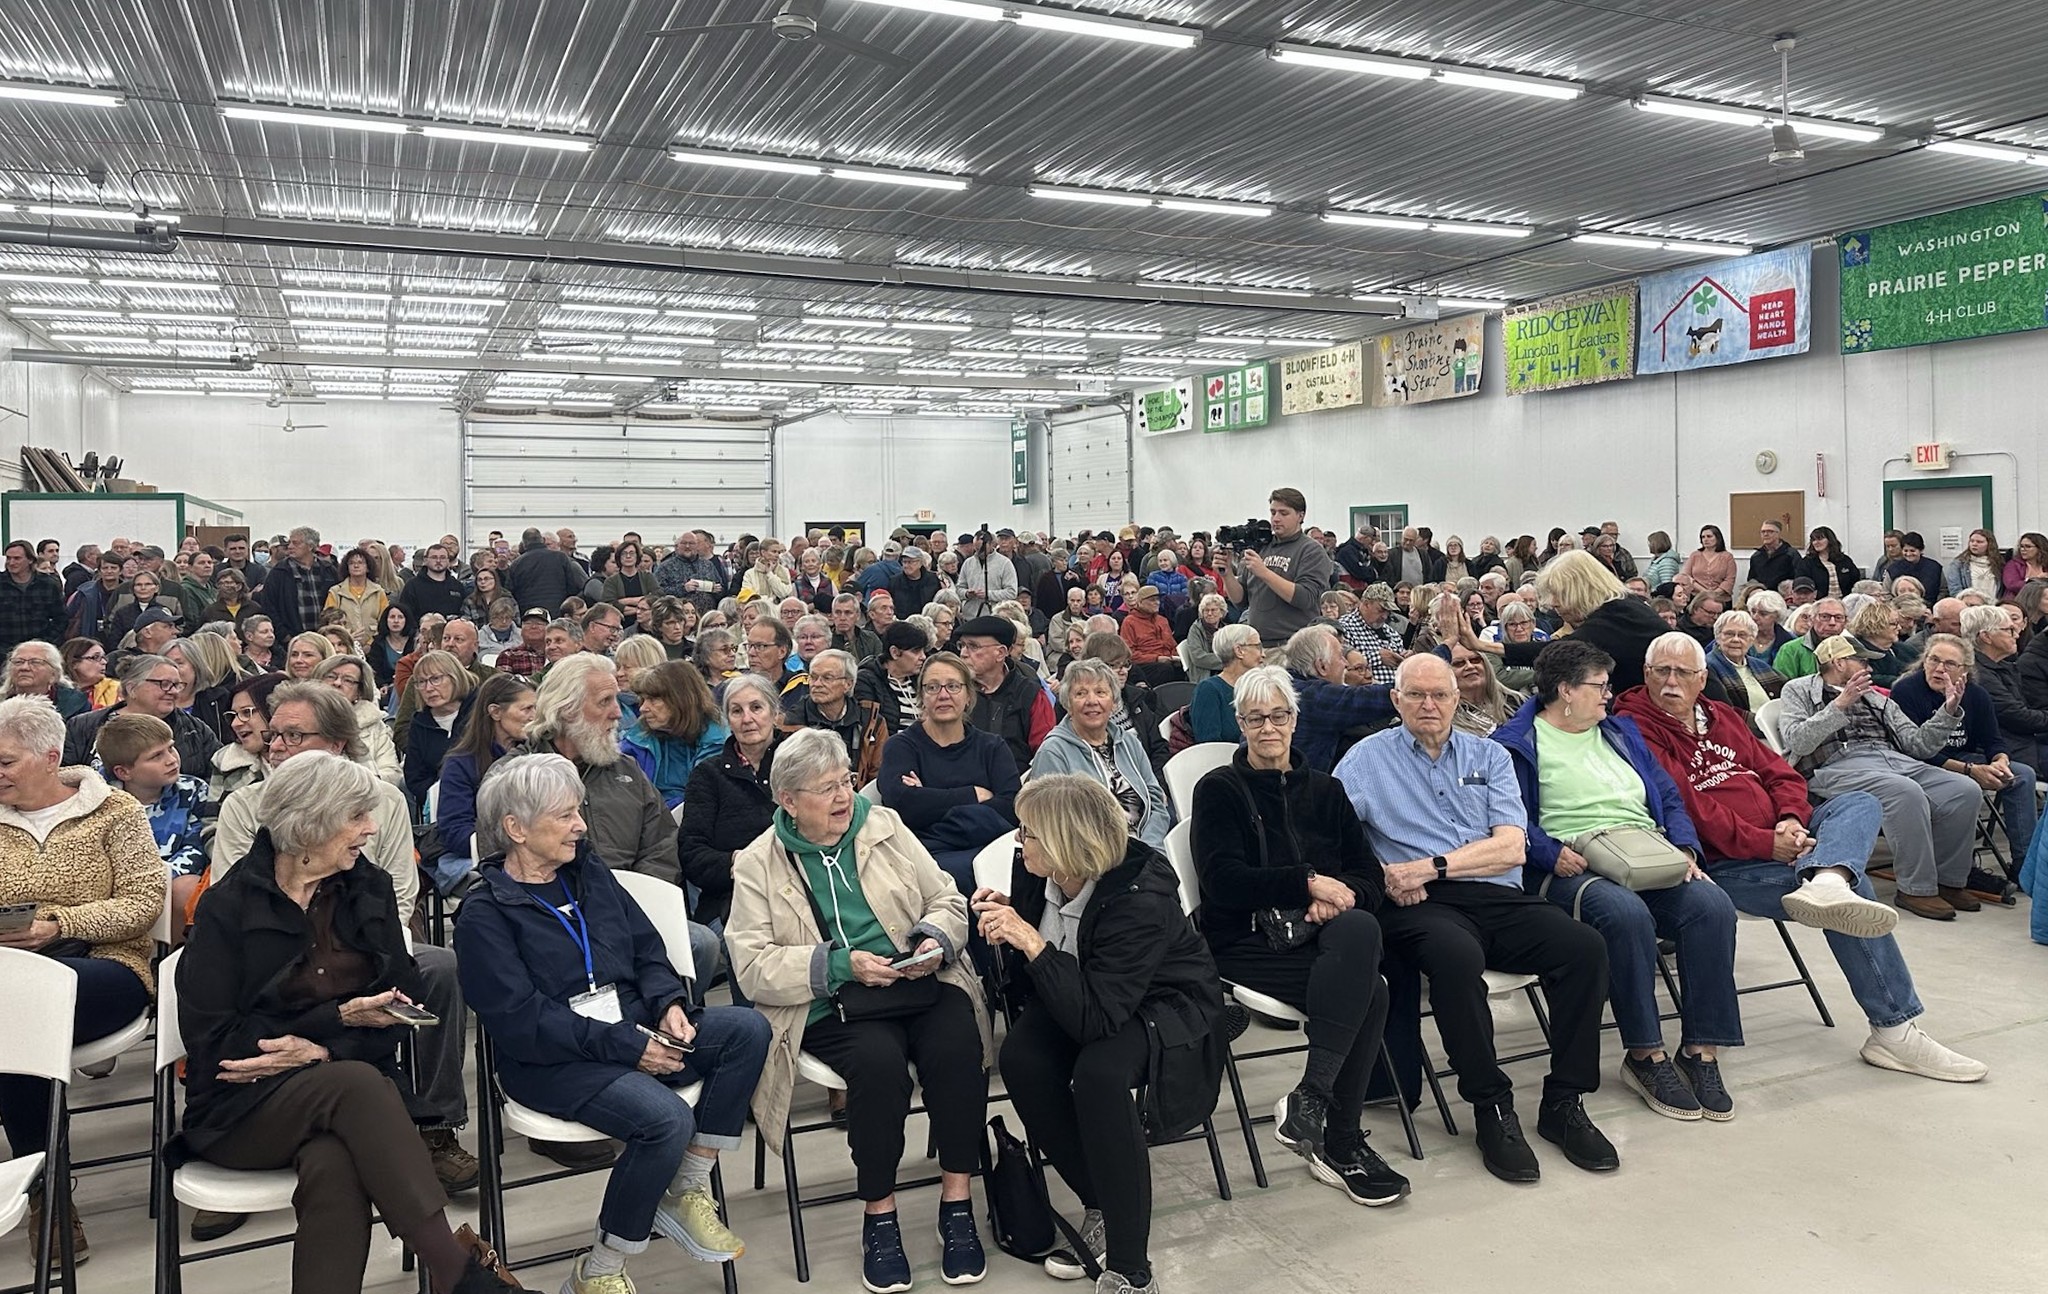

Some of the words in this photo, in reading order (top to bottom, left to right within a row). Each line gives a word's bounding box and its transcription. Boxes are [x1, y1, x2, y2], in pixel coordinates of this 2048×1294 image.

[1898, 222, 2020, 257] WASHINGTON
[1868, 270, 1948, 299] PRAIRIE
[1758, 310, 1785, 321] HEART
[1761, 300, 1784, 311] HEAD
[1925, 308, 1952, 325] 4-H
[1956, 301, 1996, 318] CLUB
[1516, 298, 1620, 341] RIDGEWAY
[1757, 320, 1786, 331] HANDS
[1514, 343, 1559, 361] Lincoln
[1568, 330, 1620, 351] Leaders
[1757, 329, 1787, 340] HEALTH
[1285, 353, 1338, 375] BLOOMFIELD
[1341, 348, 1356, 364] 4-H
[1405, 352, 1451, 376] Shooting
[1550, 355, 1580, 379] 4-H
[1916, 444, 1940, 463] EXIT
[921, 510, 932, 518] EXIT
